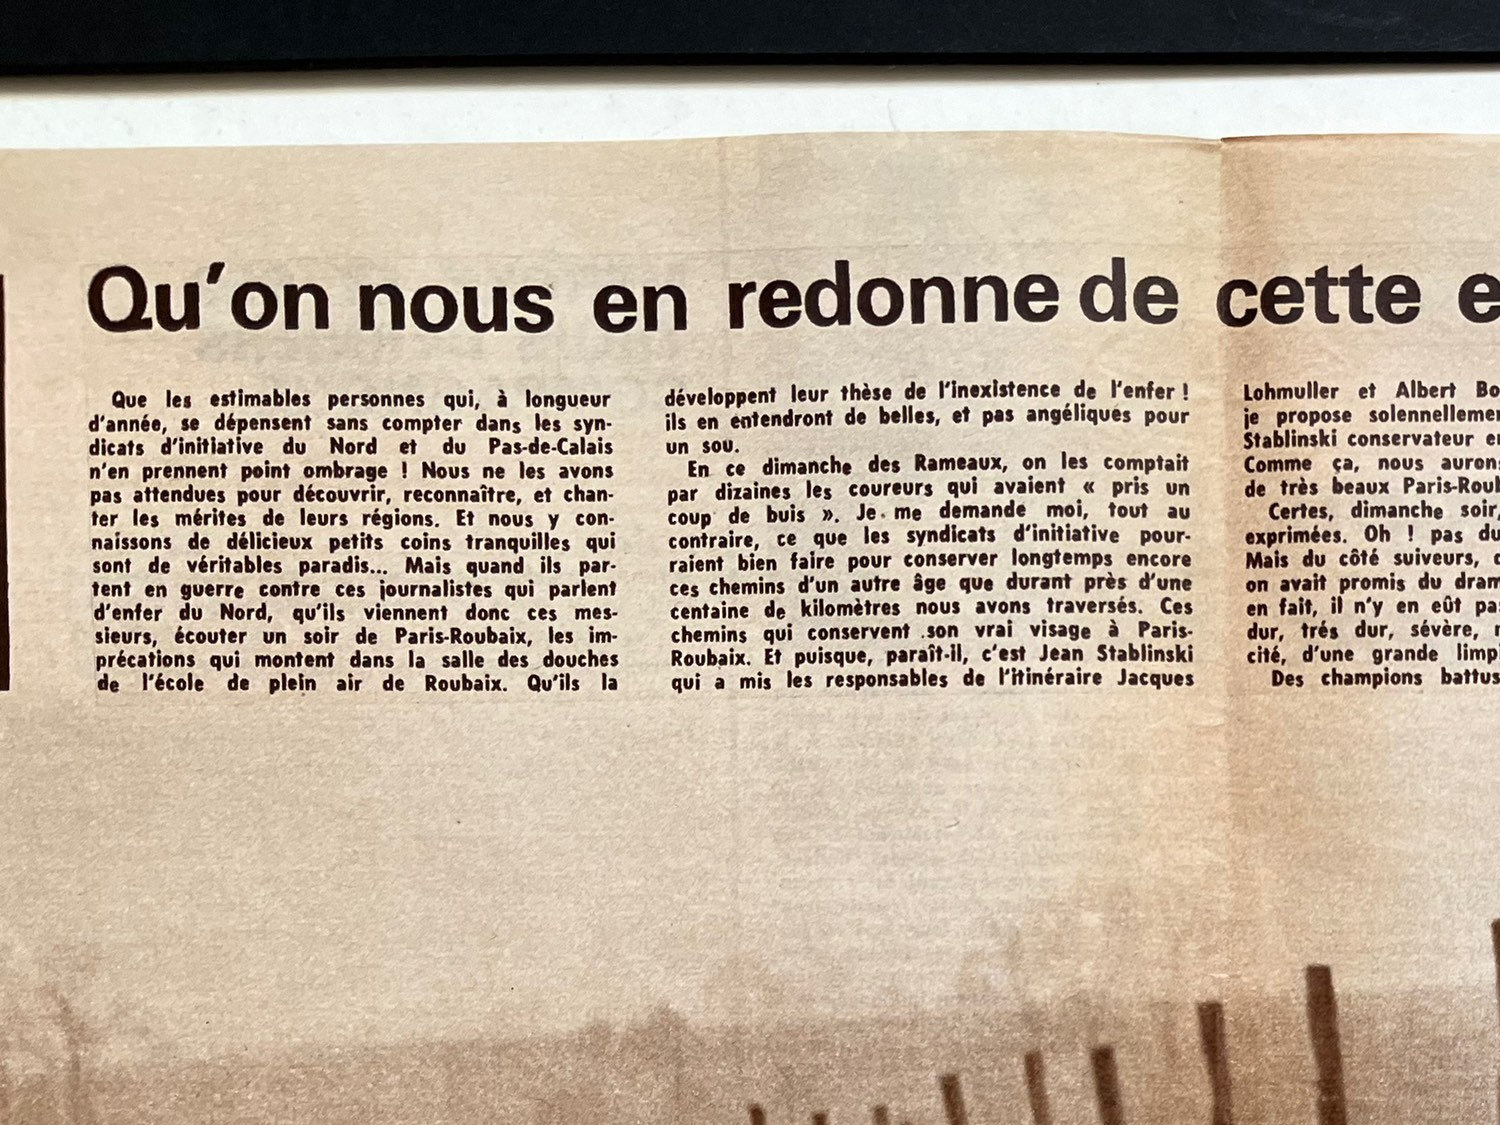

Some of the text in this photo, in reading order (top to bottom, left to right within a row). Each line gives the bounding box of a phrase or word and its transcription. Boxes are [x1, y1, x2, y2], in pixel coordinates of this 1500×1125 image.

[88, 262, 328, 332] Qu'on
[360, 284, 553, 333] nous
[594, 285, 686, 333] en
[729, 260, 1058, 329] redonne
[1080, 257, 1178, 324] de
[1217, 265, 1420, 327] cette
[111, 388, 611, 412] Que les estimables personnes qui, à longueur
[1243, 380, 1339, 402] Lohmuller
[1358, 382, 1377, 399] et
[1395, 379, 1457, 399] Albert
[1243, 428, 1337, 450] Stablinski
[1347, 430, 1475, 447] conservateur
[688, 451, 1189, 478] En ce dimanche des Rameaux, on les comptait
[90, 483, 614, 507] pas attendues pour découvrir, reconnaître, et chan-
[1268, 502, 1334, 522] Certes,
[1350, 499, 1443, 520] dimanche
[669, 547, 1192, 573] raient bien faire pour conserver longtemps encore
[91, 578, 617, 602] tent en guerre contre ces journalistes qui parlent
[670, 595, 1193, 620] centaine de kilomètres nous avons traversés. Ces
[96, 648, 619, 672] précations qui montent dans la salle des douches
[1271, 669, 1304, 688] Des
[1321, 666, 1423, 690] champions
